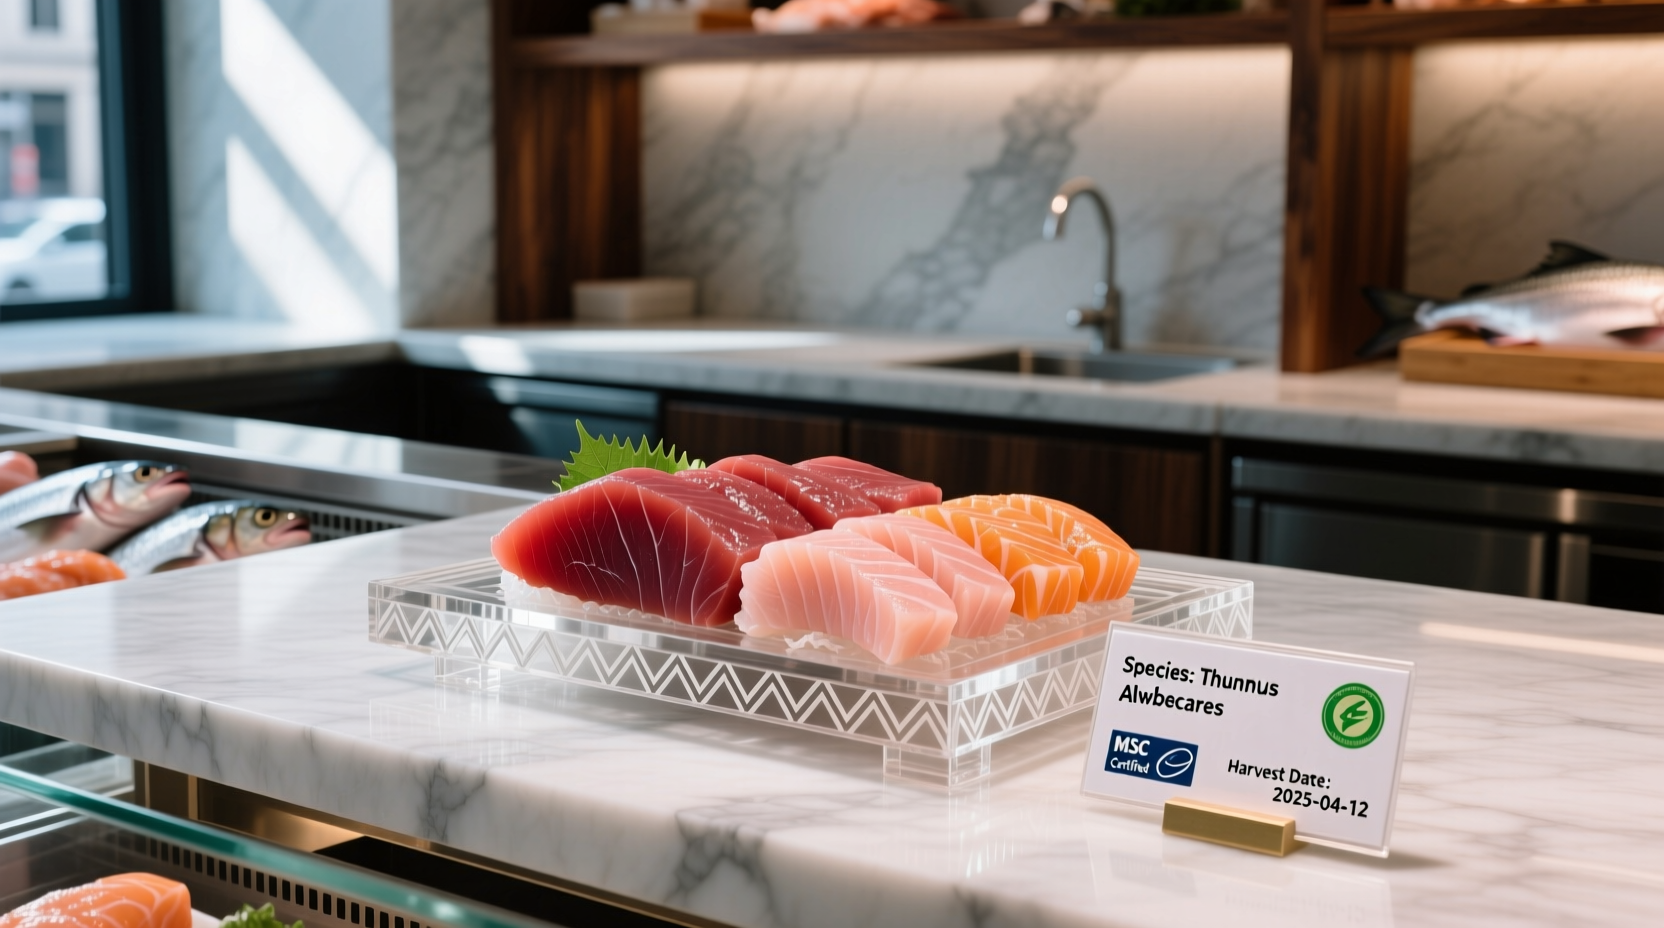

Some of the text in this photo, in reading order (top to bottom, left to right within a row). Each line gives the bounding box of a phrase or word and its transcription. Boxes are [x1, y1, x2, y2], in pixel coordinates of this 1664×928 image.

[1122, 655, 1279, 697] Species: Thunnus
[1118, 684, 1225, 717] Alwbecares
[1113, 735, 1151, 756] MSC
[1227, 759, 1331, 790] Harvest Date:
[1272, 786, 1369, 819] 2025-04-12
